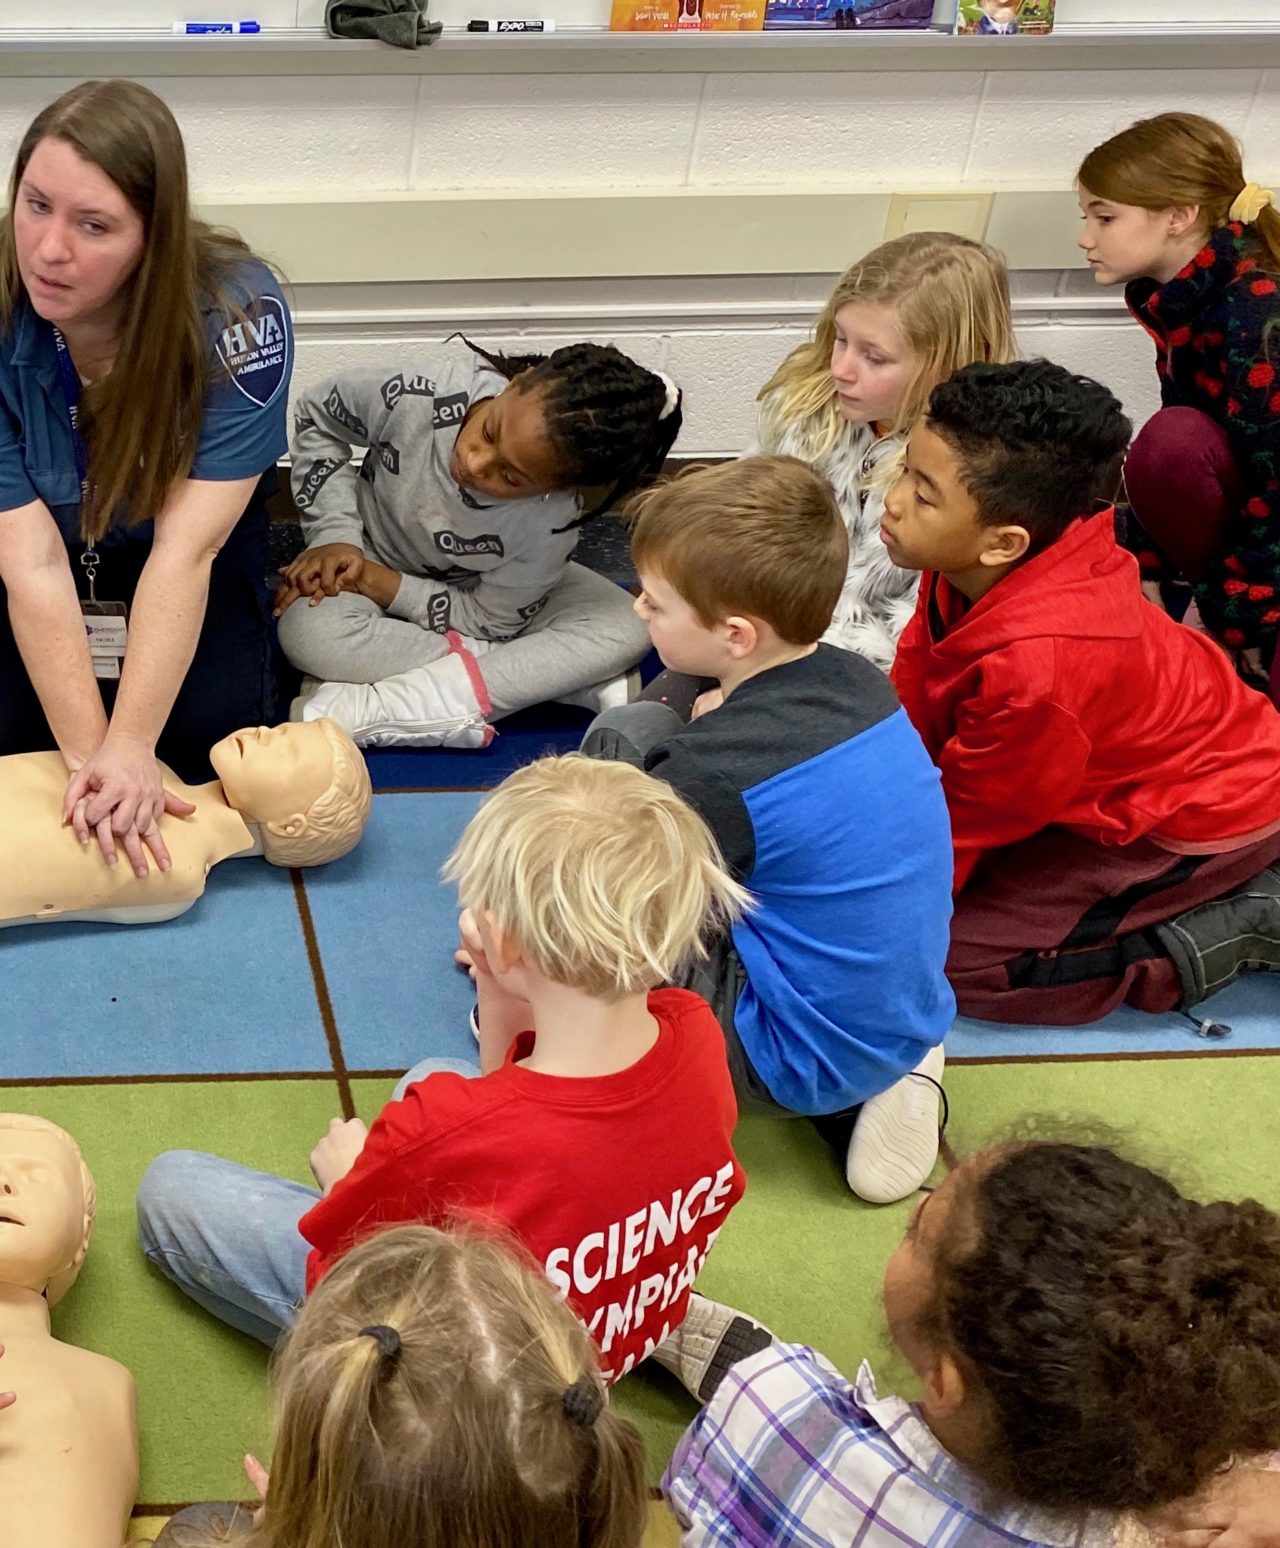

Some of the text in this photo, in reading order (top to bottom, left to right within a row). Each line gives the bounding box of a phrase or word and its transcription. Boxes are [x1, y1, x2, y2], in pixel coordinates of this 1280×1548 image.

[500, 22, 525, 33] EXPO
[222, 313, 284, 357] HVA
[261, 342, 284, 357] VALLEY
[237, 354, 283, 375] AMBULANCE
[295, 458, 340, 507] Queen
[439, 533, 502, 553] Queen
[545, 1160, 734, 1301] SCIENCE
